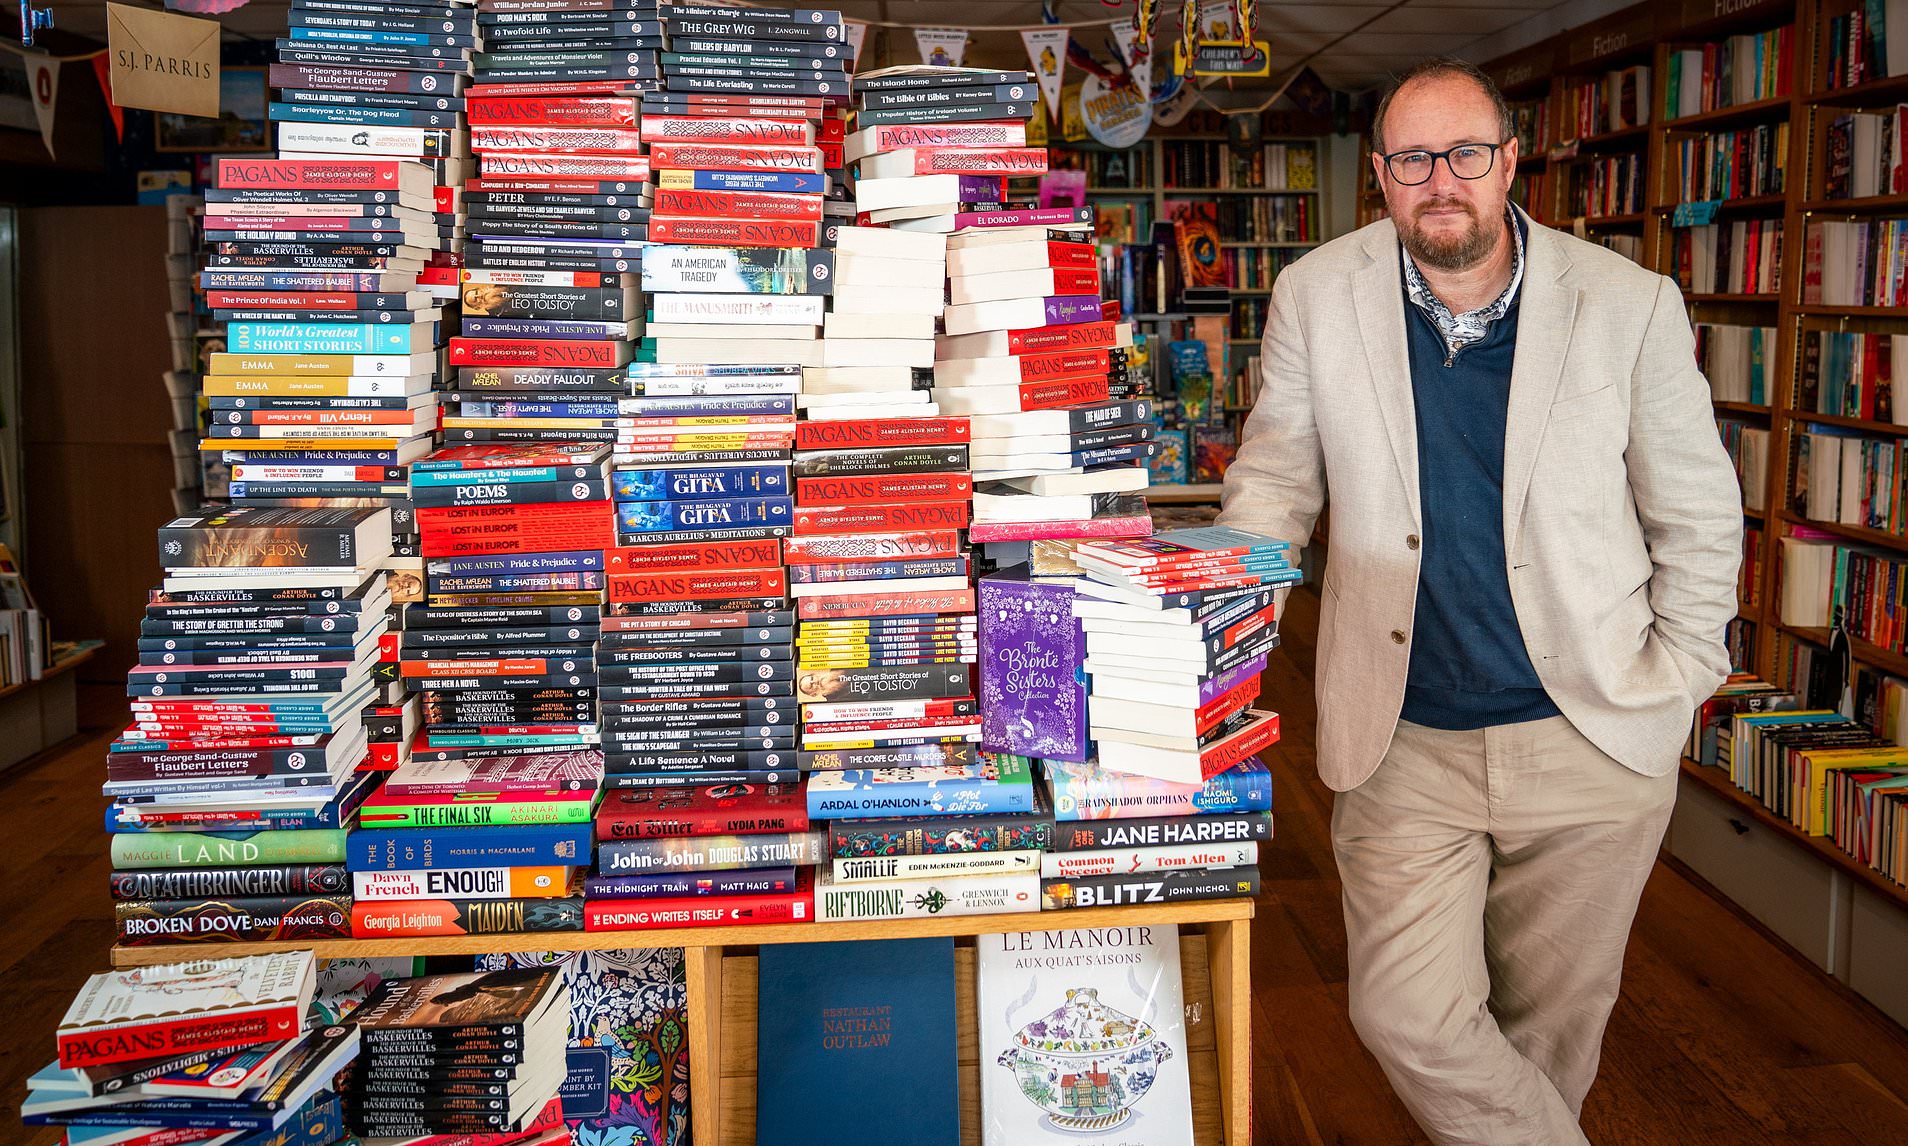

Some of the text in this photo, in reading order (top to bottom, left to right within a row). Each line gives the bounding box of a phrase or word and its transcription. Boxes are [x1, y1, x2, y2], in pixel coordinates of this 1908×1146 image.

[680, 22, 701, 33] THE
[704, 23, 731, 34] GREY
[733, 24, 755, 35] WIG
[775, 27, 810, 35] ZANGWILL
[1593, 32, 1627, 58] Fiction
[295, 52, 351, 62] Quill's Window
[119, 50, 211, 79] S.J. PARRIS
[472, 103, 539, 119] PAGANS
[881, 130, 943, 145] PAGANS
[225, 167, 297, 183] PAGANS
[488, 193, 524, 203] PETER
[977, 216, 1019, 225] EL DORADO
[235, 231, 296, 240] THE HOLIDAY ROUND
[671, 259, 727, 269] AN AMERICAN
[680, 272, 717, 282] TRAGEDY
[511, 299, 576, 310] LEO TOLSTOY
[255, 326, 359, 338] World's Greatest
[254, 340, 363, 351] SHORT STORIES
[543, 347, 610, 361] PAGANS
[242, 361, 274, 370] EMMA
[514, 374, 595, 385] DEADLY FALLOUT
[320, 412, 372, 423] Henry VIII
[802, 425, 872, 442] PAGANS
[456, 485, 507, 499] POEMS
[673, 478, 725, 493] GITA
[481, 507, 515, 517] EUROPE
[680, 508, 732, 525] GITA
[629, 529, 766, 542] MARCUS AURELIUS MEDITATIONS
[510, 557, 577, 568] Pride & Prejudice
[614, 579, 685, 596] PAGANS
[643, 605, 702, 613] BASKERVILLES
[172, 619, 284, 629] THE STORY OF GRETTIR THE STRONG
[1023, 641, 1041, 654] The
[1000, 648, 1060, 671] Brontë
[1006, 671, 1056, 693] Sisters
[1018, 689, 1050, 701] Collection
[636, 704, 663, 712] Border
[665, 703, 688, 711] Rifles
[142, 752, 258, 763] The George Sand-Gustave
[849, 752, 947, 764] THE CORFE CASTLE MURDERS
[154, 761, 249, 771] Flaubert Letters
[820, 798, 920, 810] ARDAL O'HANLON
[1085, 794, 1188, 809] RAINSHADOW ORPHANS
[1197, 796, 1238, 805] ISHIGURO
[414, 806, 492, 825] THE FINAL SIX
[510, 805, 559, 814] AKINARI
[511, 814, 558, 822] ASAKURA
[727, 820, 756, 831] LYDIA
[758, 818, 785, 829] PANG
[1100, 821, 1250, 846] JANE HARPER
[123, 851, 171, 861] MAGGIE
[177, 842, 259, 863] LAND
[368, 839, 432, 868] THE BOOK OF BIRDS
[610, 853, 652, 869] John
[664, 850, 704, 866] John
[709, 847, 758, 864] DOUGLAS
[762, 843, 804, 861] STUART
[1058, 856, 1115, 868] Common
[1155, 854, 1226, 867] Tom Allen
[843, 859, 898, 879] SMALLIE
[929, 860, 1005, 870] McKENZIE-GODDARD
[136, 870, 285, 898] DEATHBRINGER
[373, 873, 411, 883] Dawn
[426, 870, 504, 894] ENOUGH
[365, 881, 420, 896] French
[594, 882, 769, 894] THE MIDNIGHT TRAIN MATT HAIG
[962, 889, 1009, 899] GRENWICH
[1076, 882, 1230, 906] BLITZ JOHN NICHOL
[825, 889, 904, 918] RIFTBORNE
[972, 899, 1005, 908] LENNOX
[364, 913, 442, 930] Georgia Leighton
[468, 902, 524, 933] MAIDEN
[603, 912, 649, 925] ENDING
[651, 910, 690, 922] WRITES
[692, 909, 724, 920] ITSELF
[126, 915, 324, 935] BROKEN DOVE DANI FRANCIS
[1002, 926, 1154, 951] LE MANOIR
[1015, 953, 1142, 970] AUX QUAT'SAISONS
[823, 1005, 892, 1018] RESTAURANT
[823, 1018, 891, 1033] NATHAN
[367, 1032, 433, 1042] BASKERVILLES
[823, 1034, 892, 1049] OUTLAW
[65, 1030, 167, 1063] PAGANS
